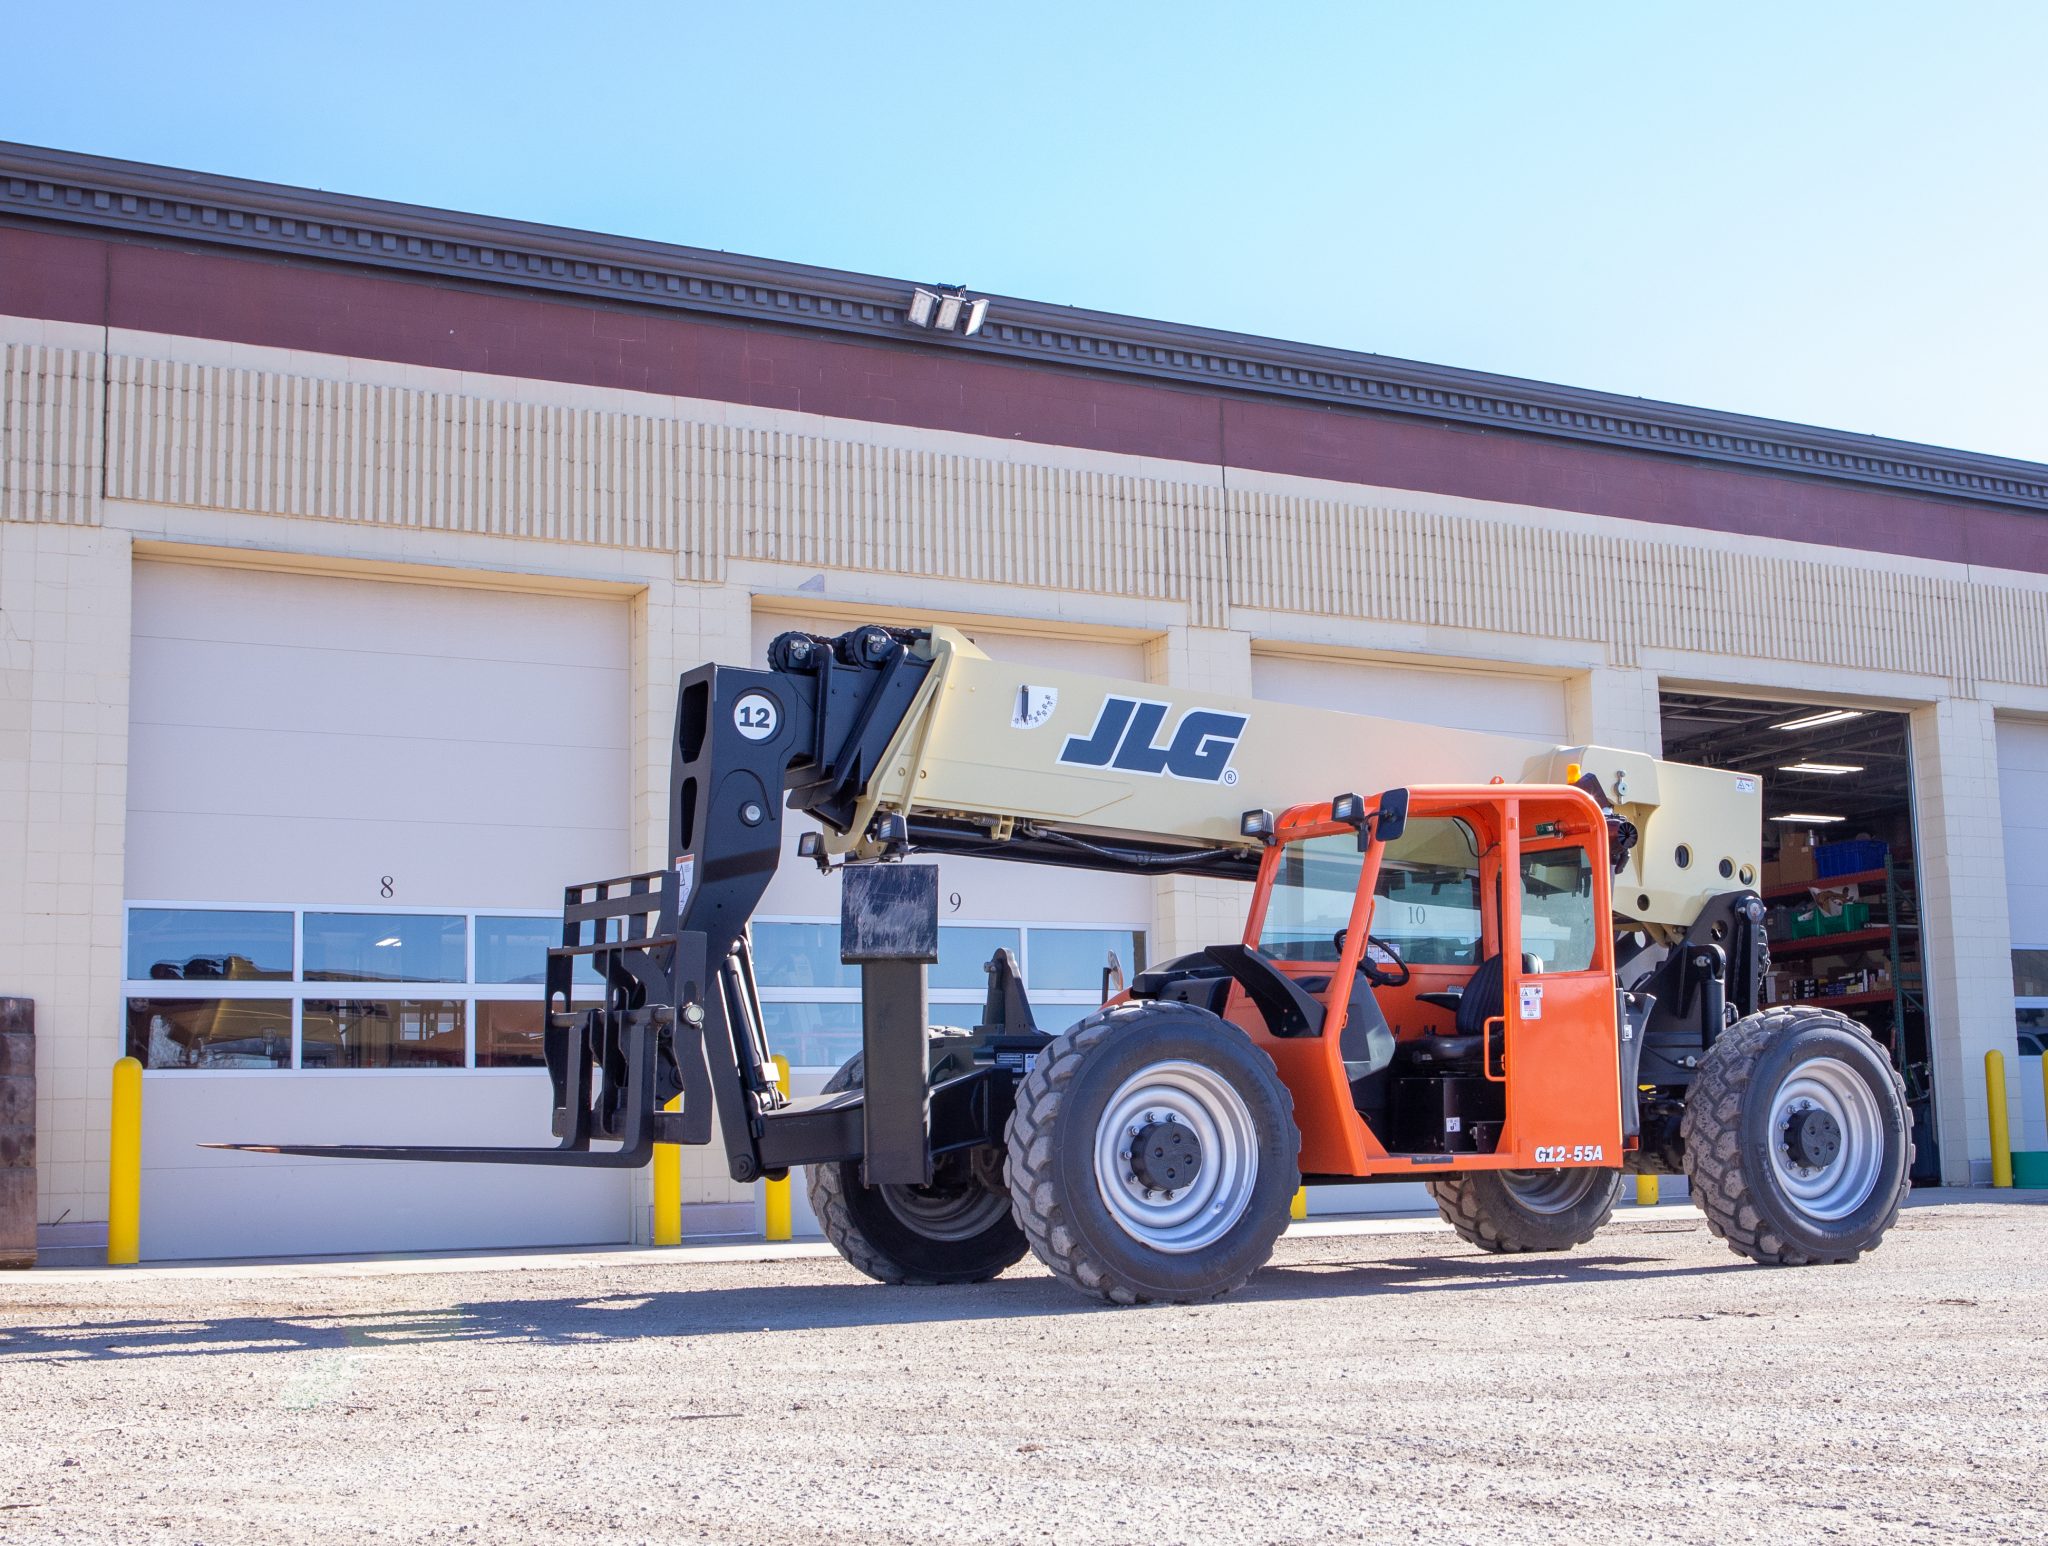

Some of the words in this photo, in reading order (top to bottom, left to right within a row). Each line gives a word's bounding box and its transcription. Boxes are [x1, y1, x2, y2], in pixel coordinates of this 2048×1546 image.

[739, 706, 771, 729] 12
[1059, 697, 1249, 782] JLG
[380, 875, 394, 899] 8
[949, 892, 962, 913] 9
[1408, 905, 1426, 925] 10
[1534, 1145, 1604, 1163] G12-55A
